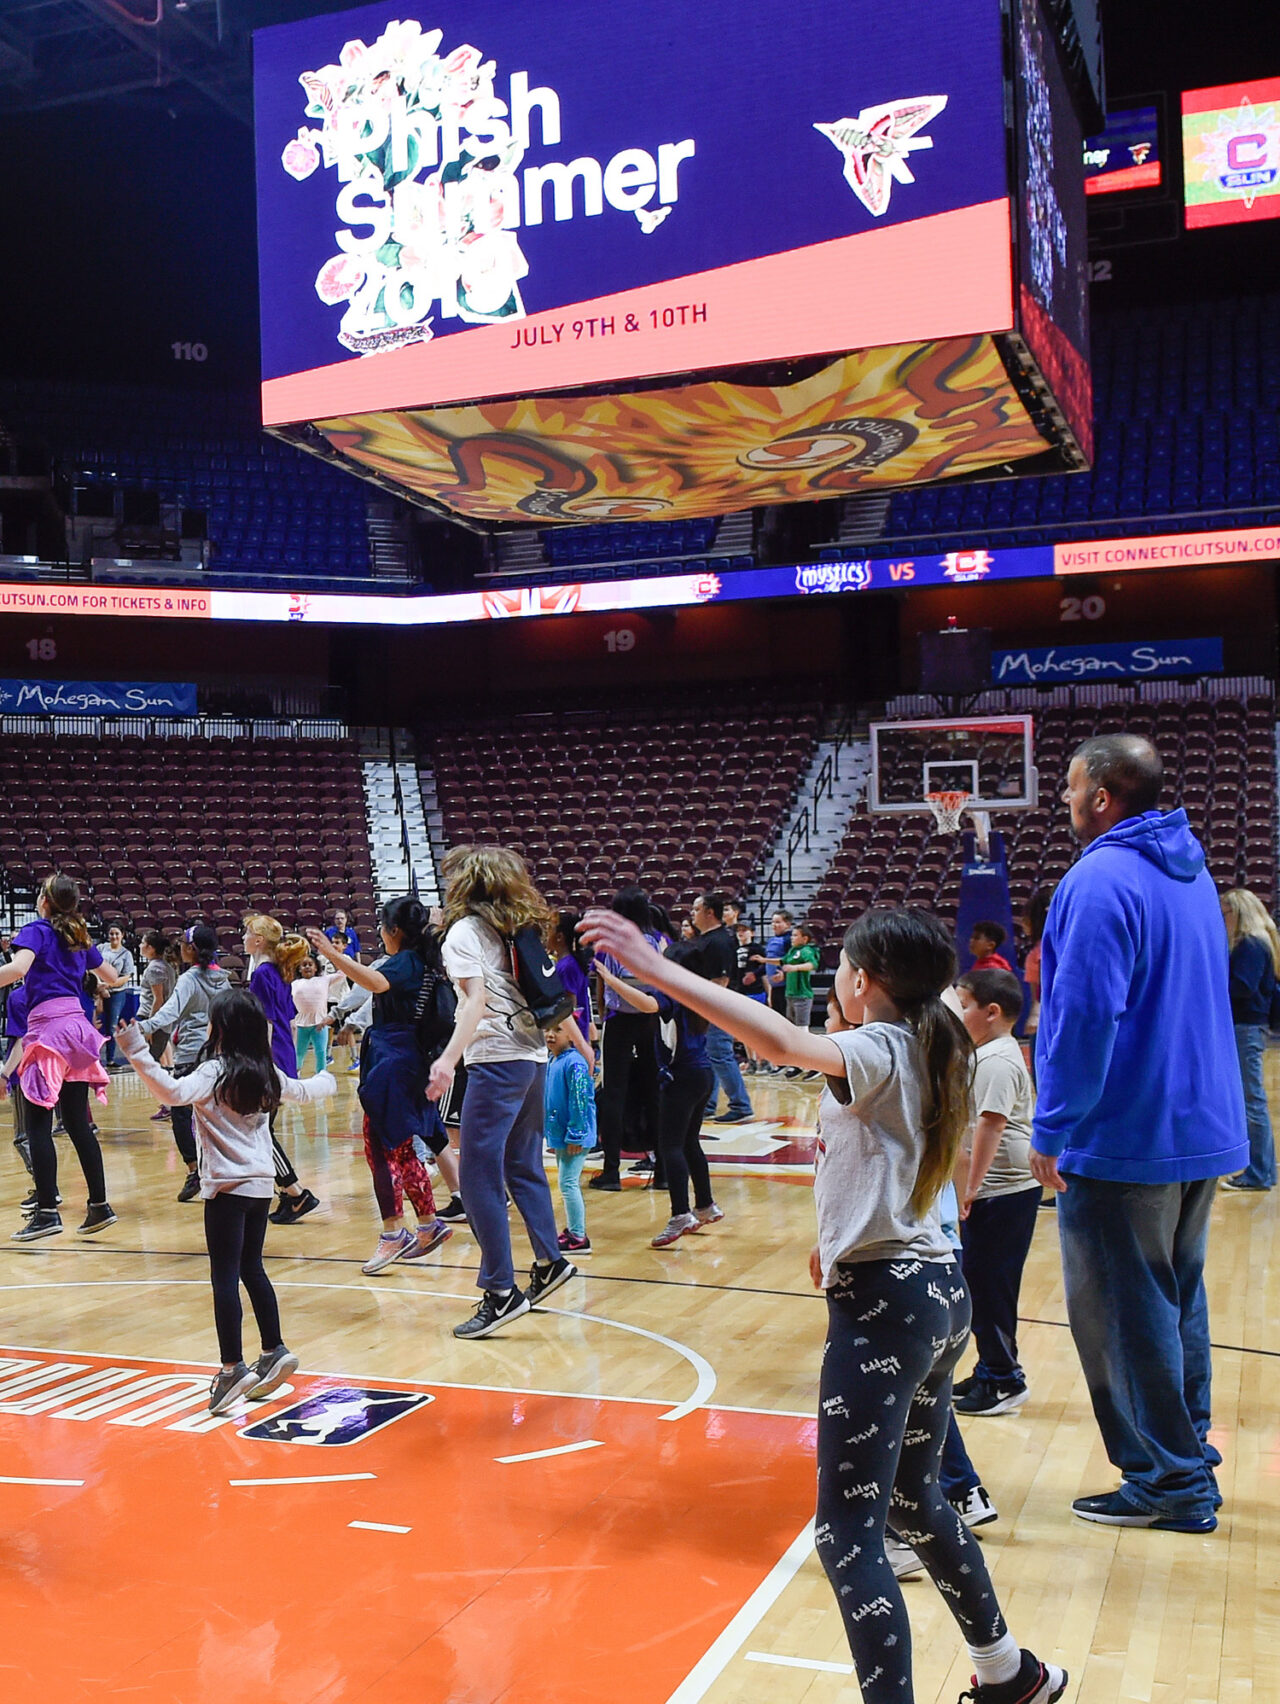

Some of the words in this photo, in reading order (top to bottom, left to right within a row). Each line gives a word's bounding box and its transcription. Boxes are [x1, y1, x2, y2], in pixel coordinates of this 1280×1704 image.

[337, 71, 561, 182] Phish
[510, 323, 565, 350] JULY
[571, 310, 616, 344] 9TH
[624, 312, 641, 333] &
[649, 303, 708, 330] 10TH
[171, 341, 208, 363] 110
[1061, 551, 1099, 566] VISIT
[889, 562, 916, 581] VS
[83, 596, 107, 609] FOR
[111, 596, 161, 610] TICKETS
[164, 599, 174, 610] &
[177, 598, 208, 611] INFO
[1060, 595, 1106, 621] 20
[25, 638, 57, 661] 18
[603, 629, 635, 653] 19
[998, 650, 1125, 680] Mohegan
[1130, 647, 1192, 672] Sun
[16, 684, 121, 711] Mohegan
[125, 688, 174, 711] Sun
